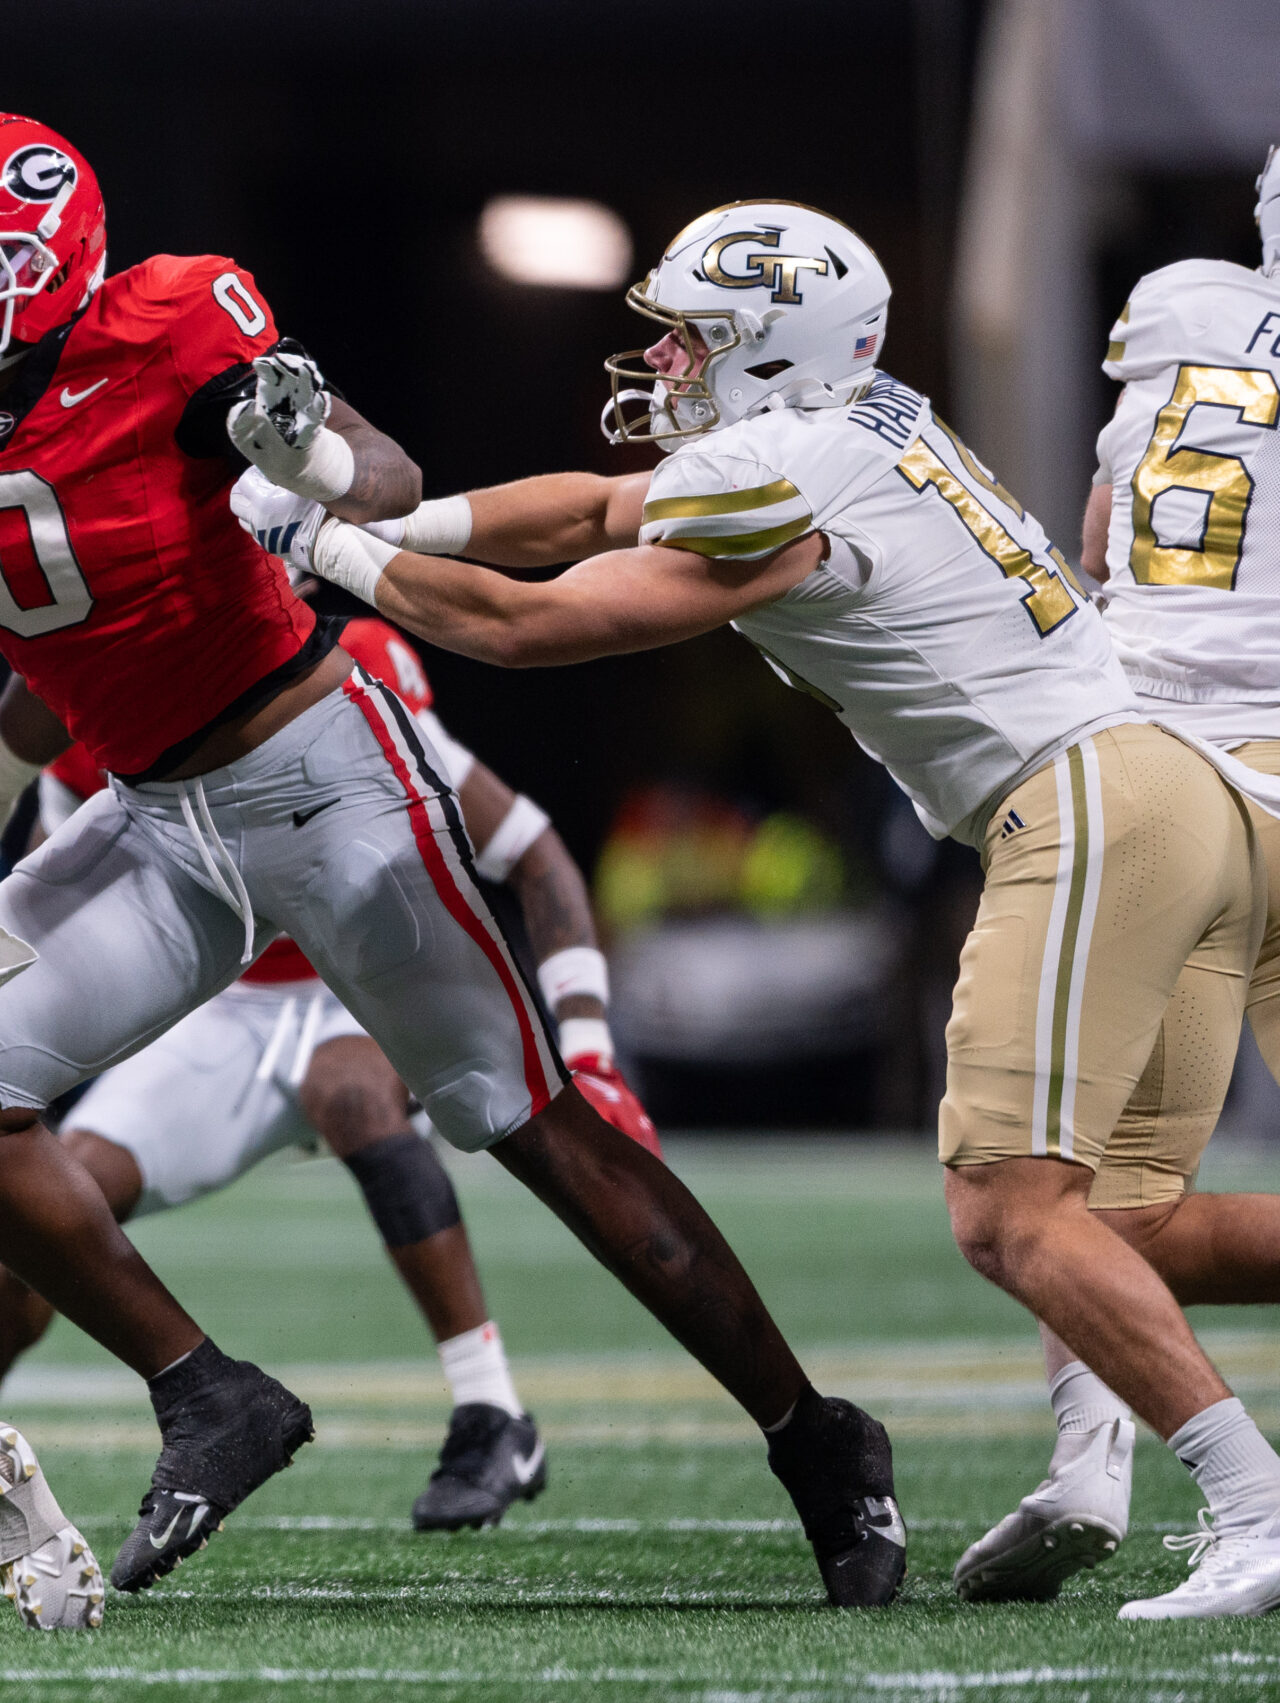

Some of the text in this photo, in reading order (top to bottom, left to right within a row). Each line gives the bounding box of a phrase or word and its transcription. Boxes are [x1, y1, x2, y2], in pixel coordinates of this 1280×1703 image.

[211, 272, 267, 338] 0
[702, 231, 828, 305] GT
[893, 406, 1090, 640] 1
[1128, 363, 1280, 592] 6
